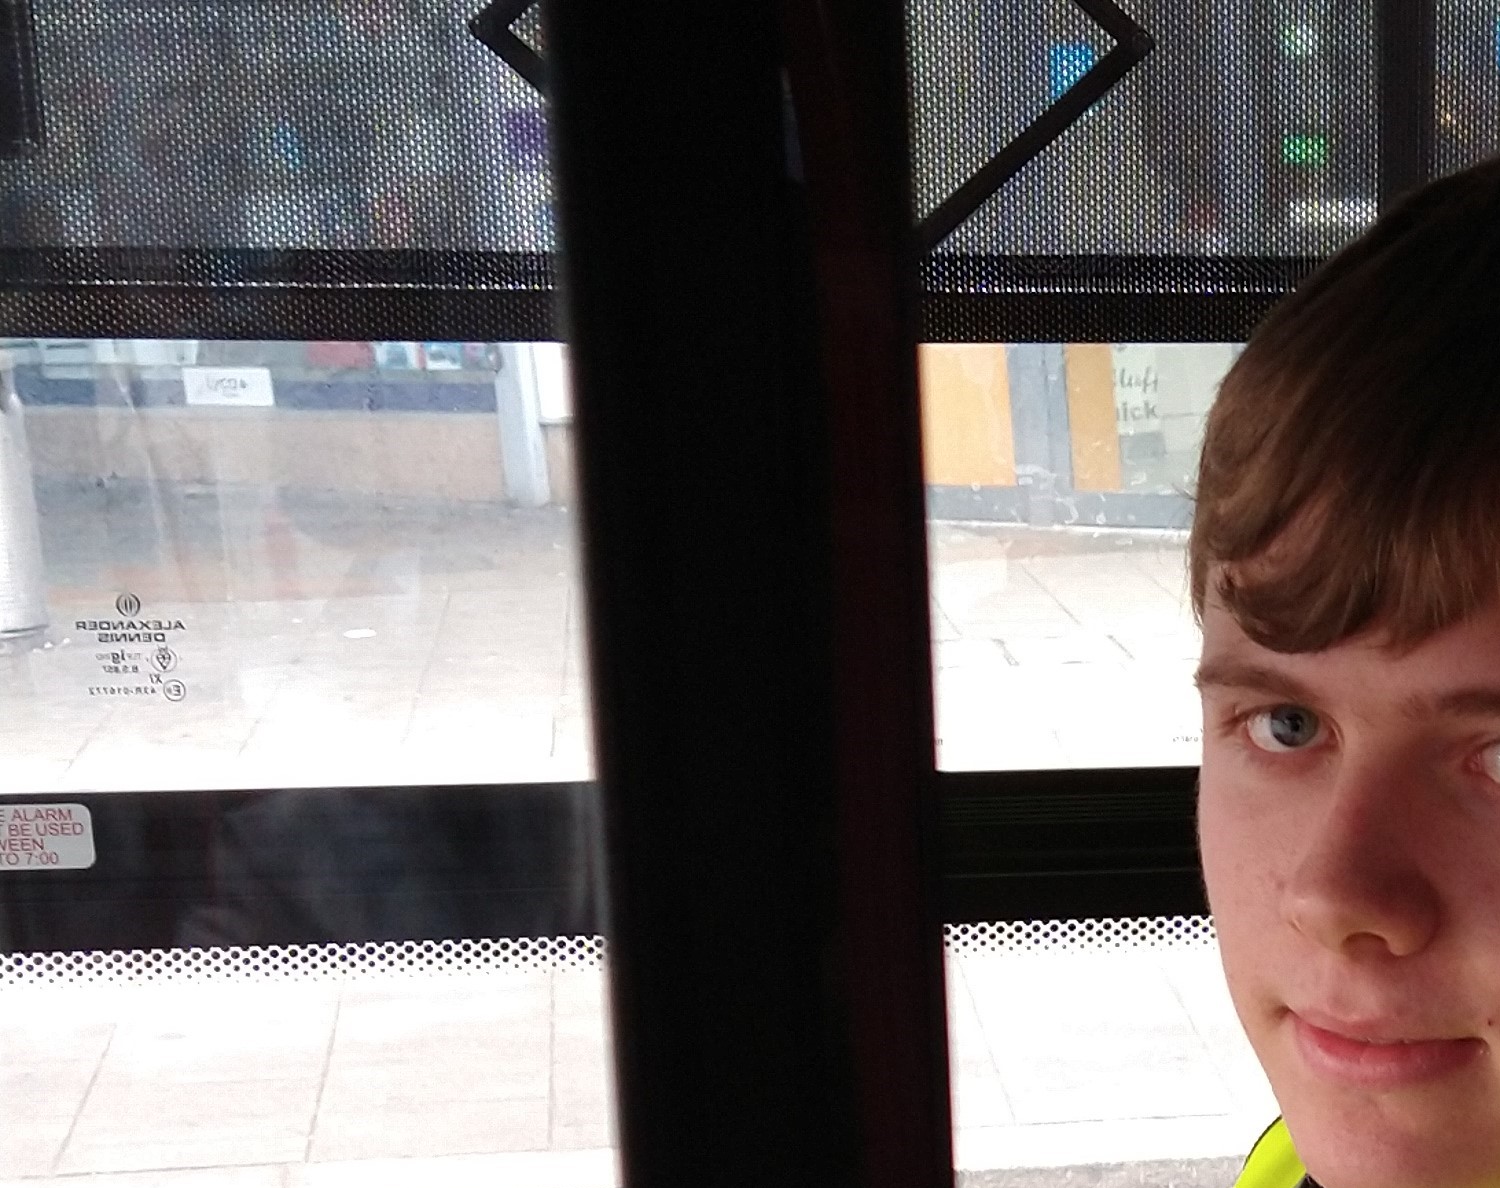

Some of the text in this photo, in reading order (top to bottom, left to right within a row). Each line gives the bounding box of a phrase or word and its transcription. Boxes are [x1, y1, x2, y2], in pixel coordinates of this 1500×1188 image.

[12, 808, 73, 821] ALARM
[8, 823, 32, 837] BE
[35, 822, 84, 837] USED
[25, 851, 59, 866] 7:00
